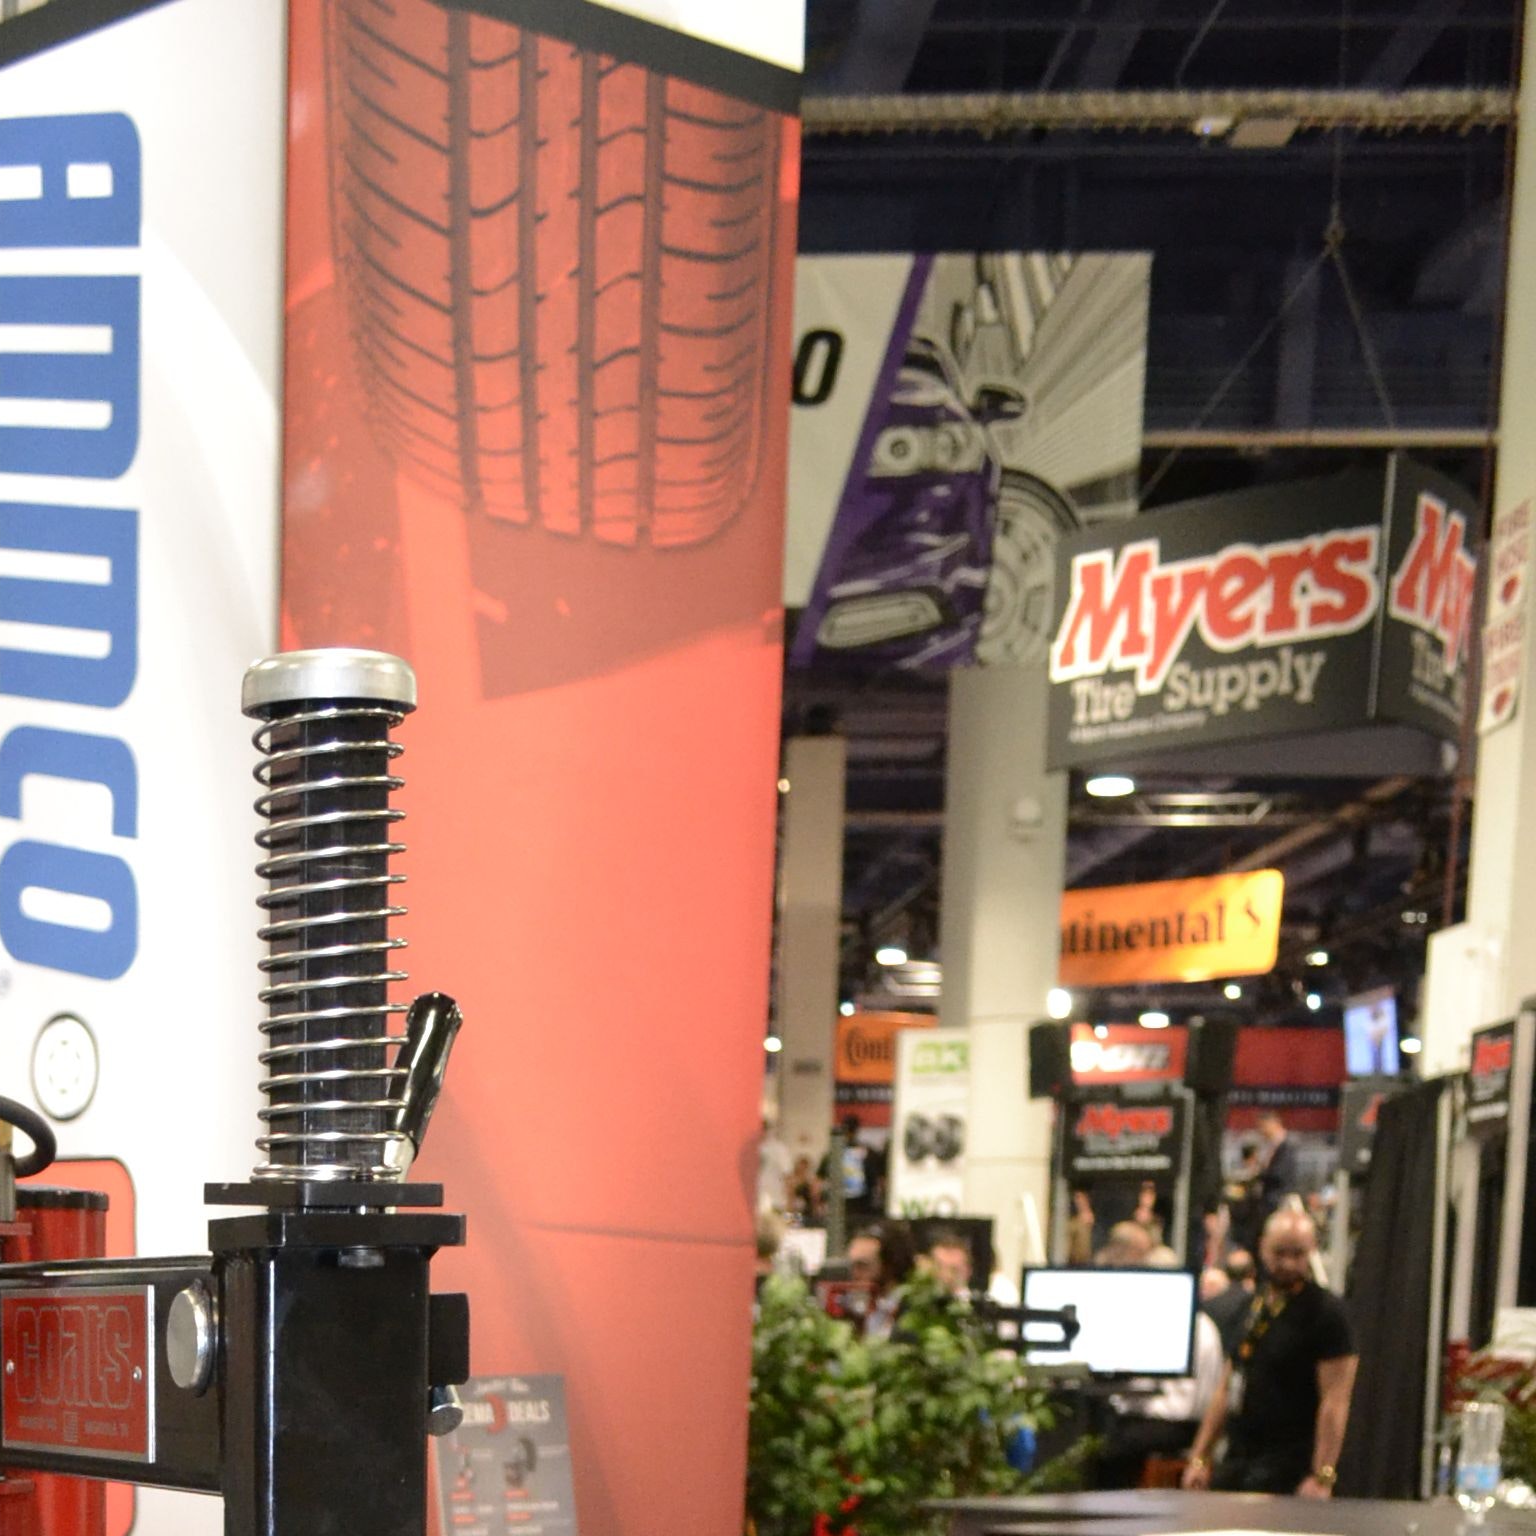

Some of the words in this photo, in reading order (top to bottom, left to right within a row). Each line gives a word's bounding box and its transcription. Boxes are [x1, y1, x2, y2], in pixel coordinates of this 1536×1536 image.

[1051, 526, 1379, 694] Myers
[1072, 680, 1137, 724] Tire
[1164, 647, 1326, 714] Supply
[1061, 899, 1226, 954] tinental
